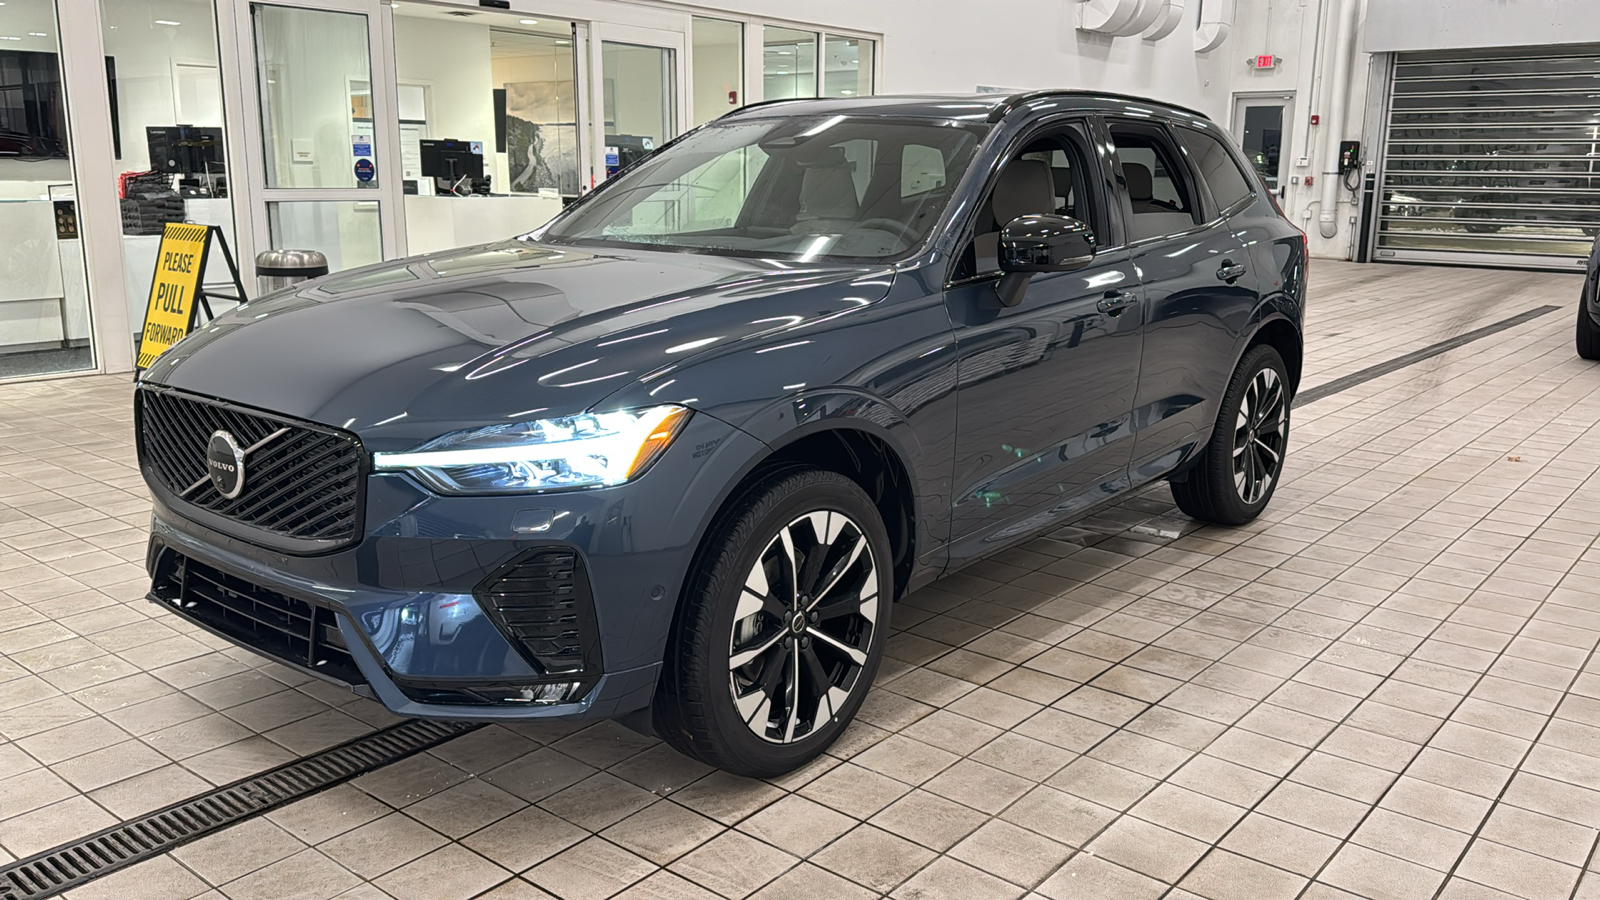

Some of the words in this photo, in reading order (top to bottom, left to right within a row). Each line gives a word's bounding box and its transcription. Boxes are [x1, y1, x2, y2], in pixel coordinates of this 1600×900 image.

[1258, 55, 1272, 67] EXIT
[163, 252, 194, 273] PLEASE
[155, 283, 184, 314] PULL
[145, 322, 183, 345] FORWARD
[208, 459, 234, 472] VOLVO
